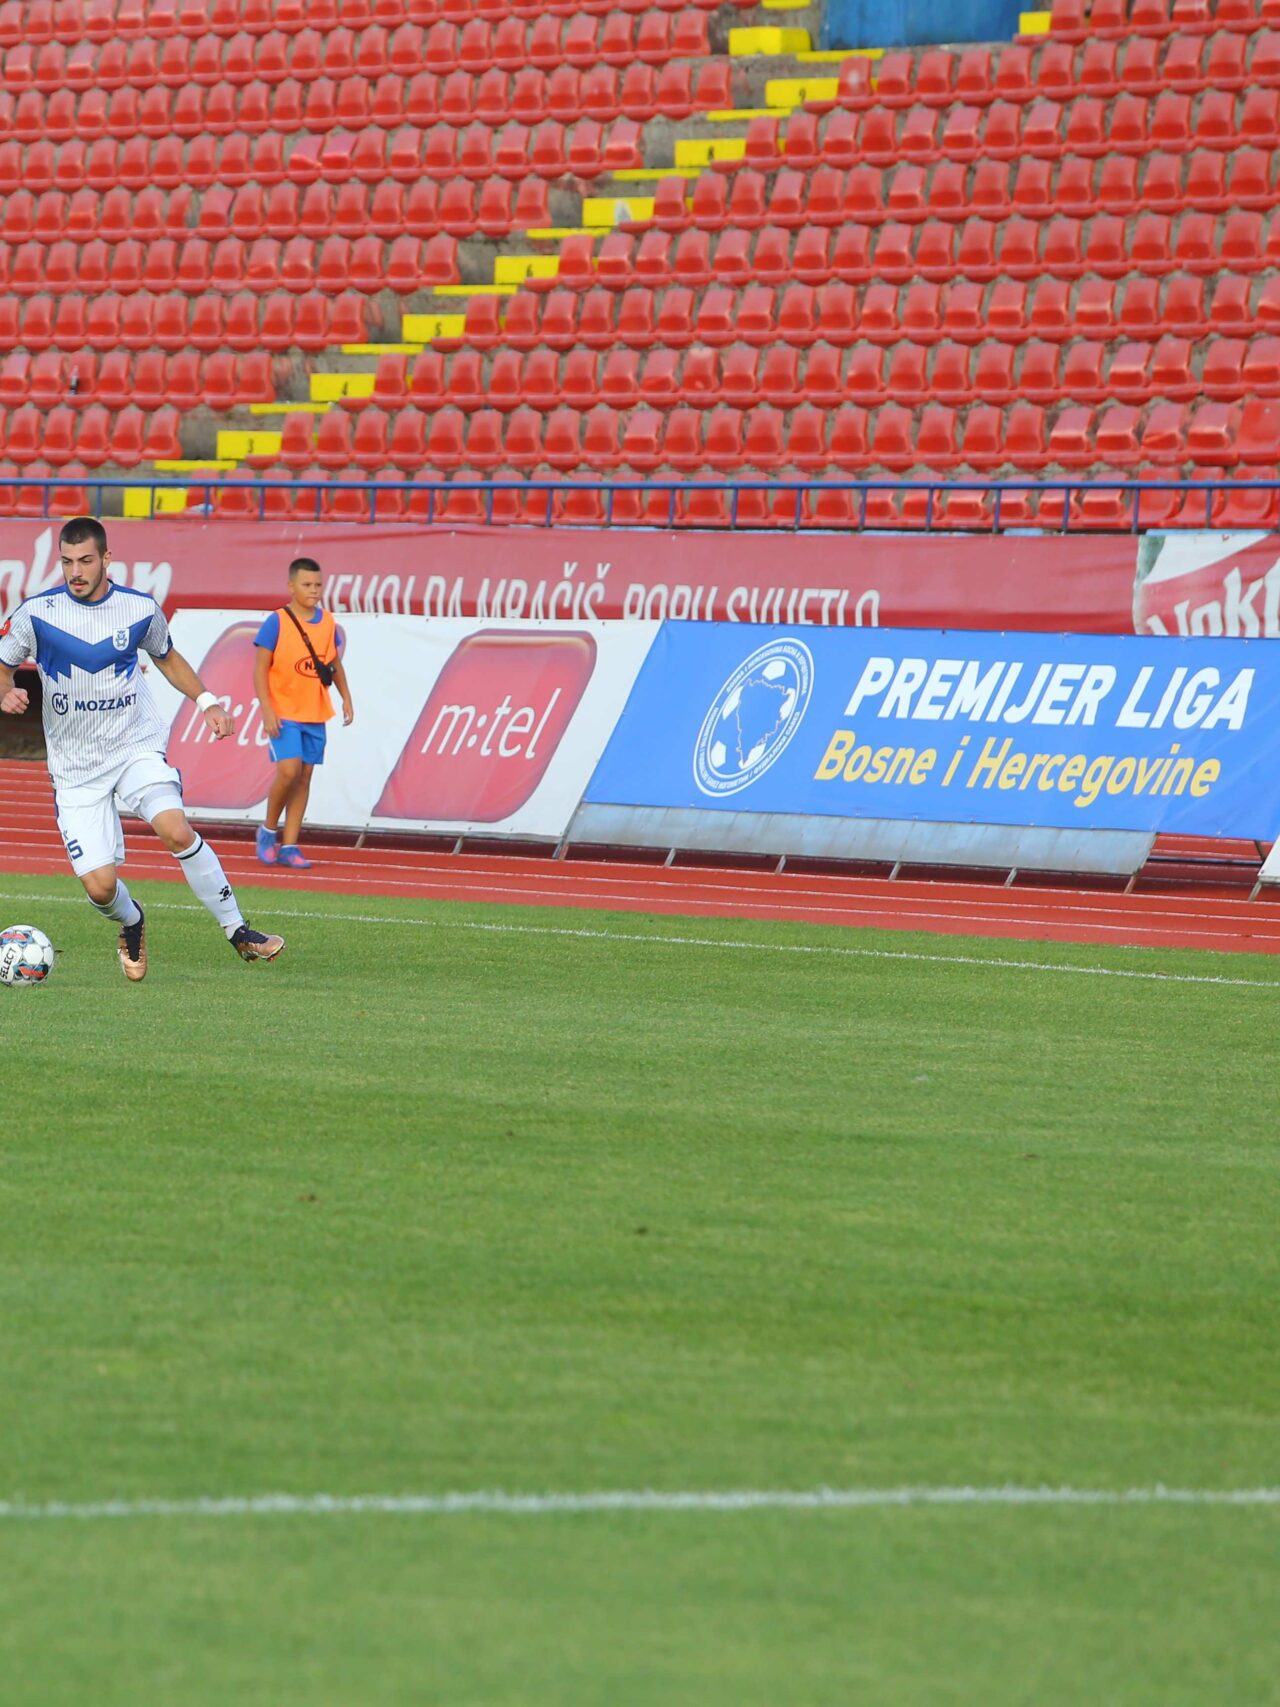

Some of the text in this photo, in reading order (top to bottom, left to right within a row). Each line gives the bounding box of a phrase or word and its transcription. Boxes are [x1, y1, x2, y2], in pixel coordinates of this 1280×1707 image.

[74, 693, 137, 711] MOZZART
[420, 687, 562, 760] m:tel
[843, 656, 1117, 726] PREMIJER
[1115, 666, 1256, 730] LIGA
[814, 729, 1221, 808] Bosne i Hercegovine
[0, 946, 17, 979] SELECT
